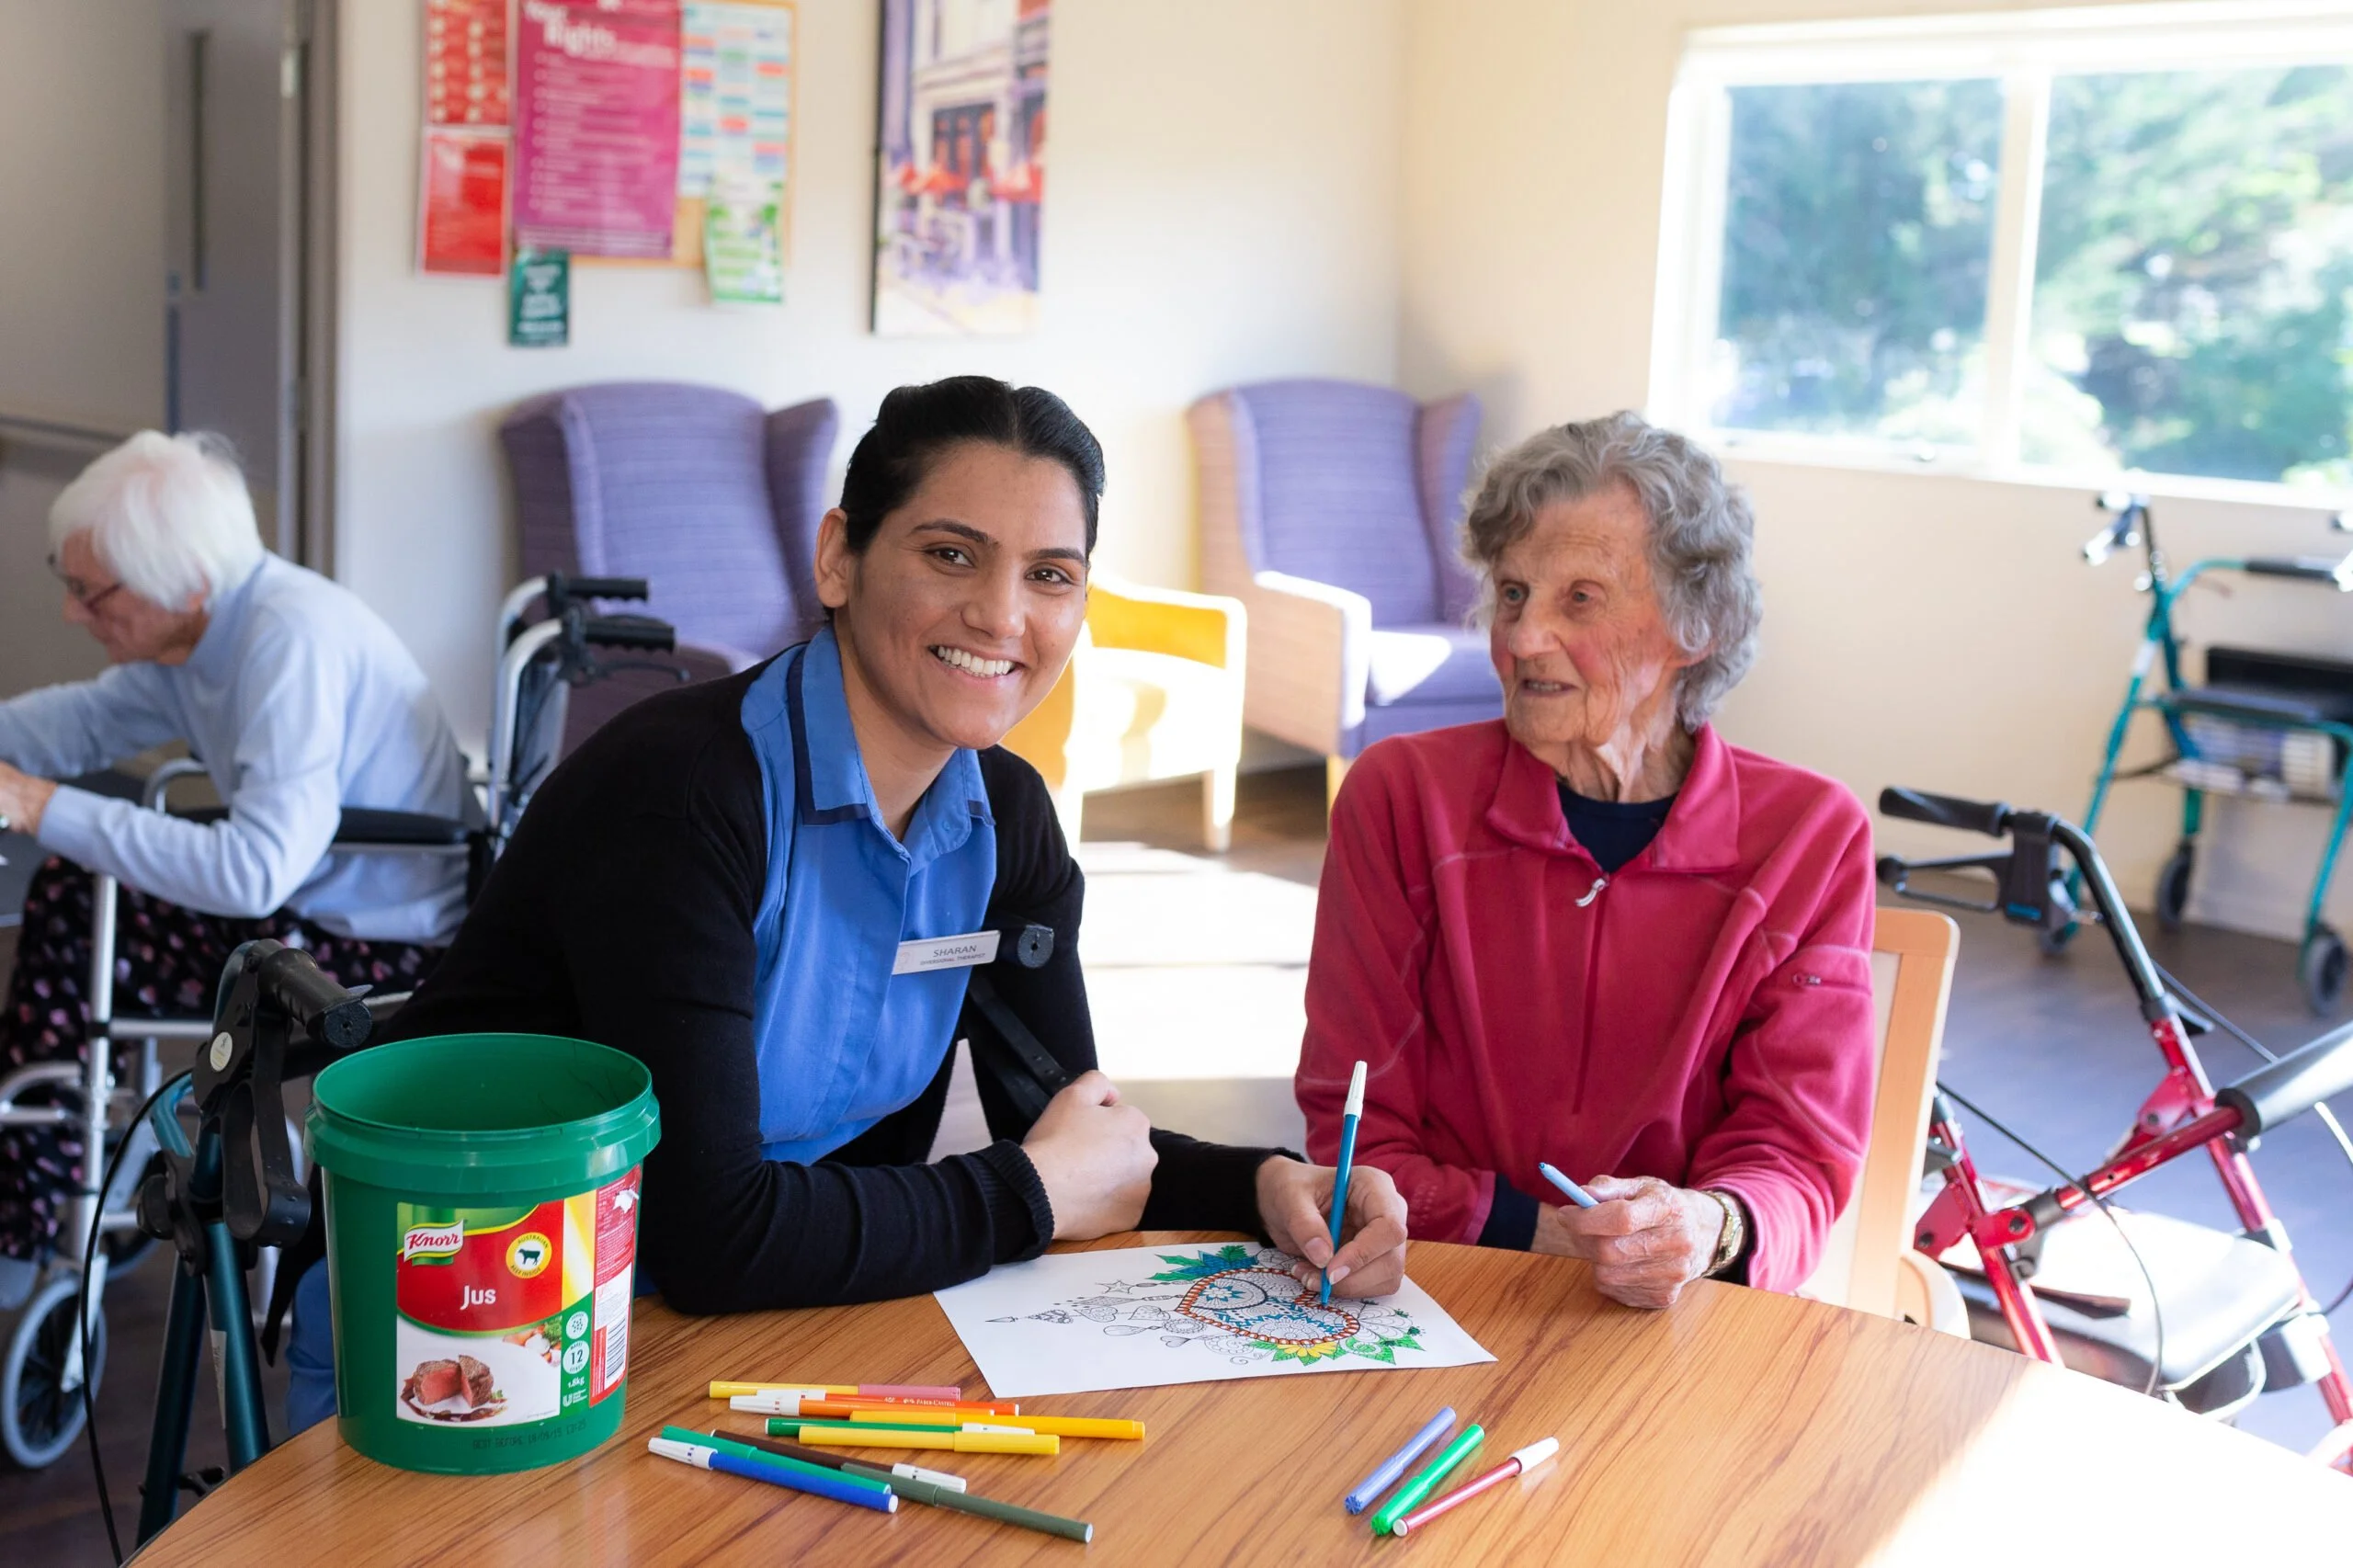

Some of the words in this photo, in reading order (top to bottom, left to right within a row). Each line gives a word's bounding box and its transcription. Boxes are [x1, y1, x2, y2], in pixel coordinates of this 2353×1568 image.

[933, 945, 977, 957] SHARAN
[957, 953, 986, 961] THERAPIST
[406, 1233, 460, 1250] Knorr
[517, 1234, 549, 1249] AUSTRALIAN
[460, 1285, 496, 1311] Jus
[571, 1348, 584, 1365] 12
[916, 1398, 956, 1407] FABER-CASTELL
[494, 1436, 523, 1448] BEFORE
